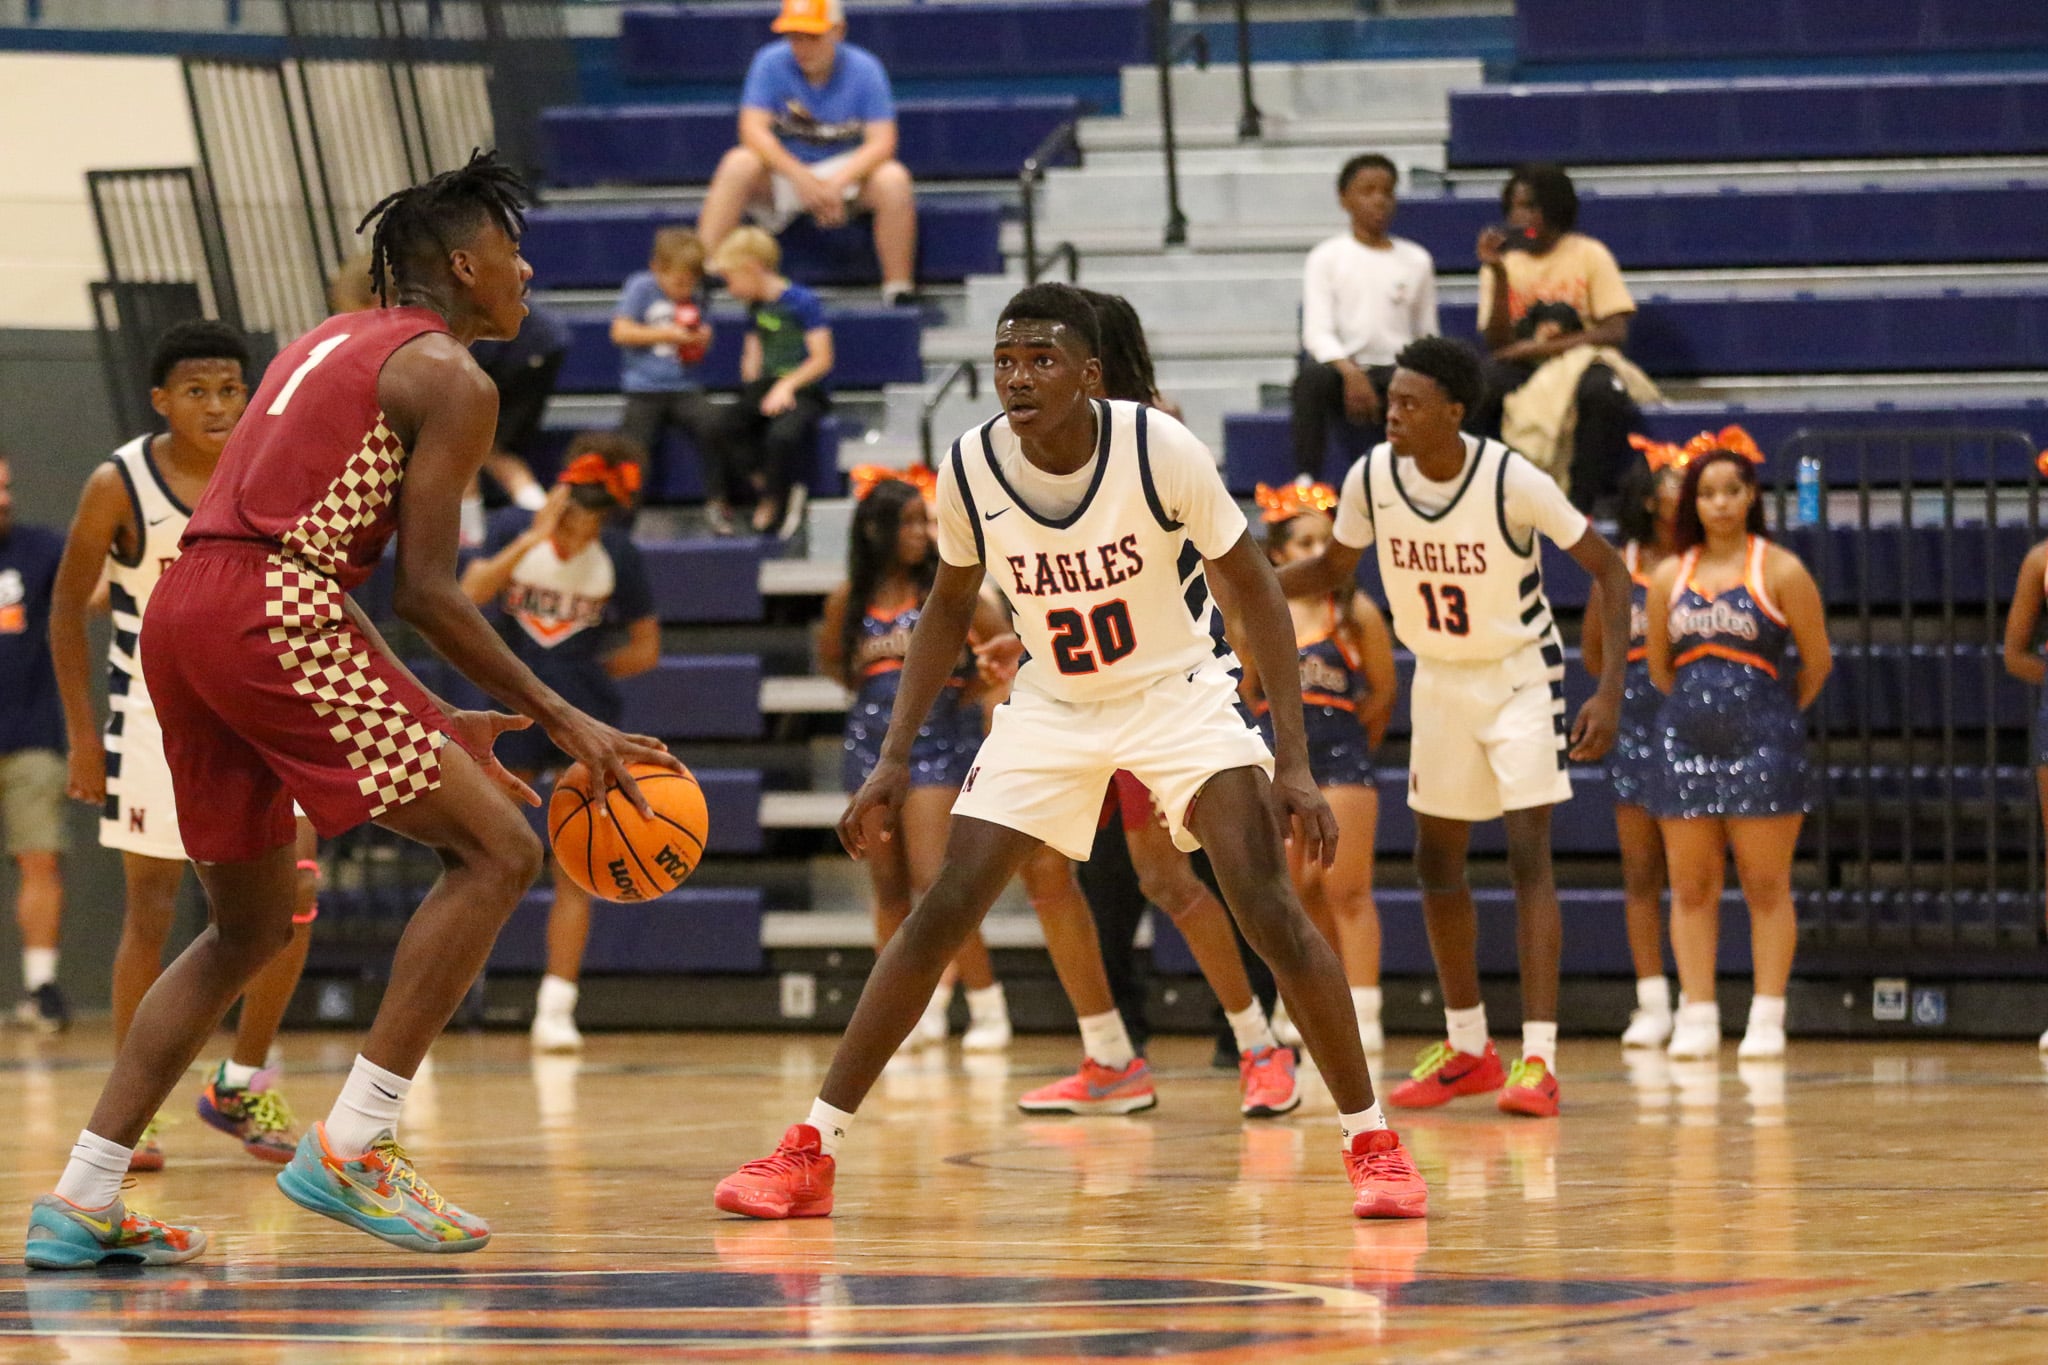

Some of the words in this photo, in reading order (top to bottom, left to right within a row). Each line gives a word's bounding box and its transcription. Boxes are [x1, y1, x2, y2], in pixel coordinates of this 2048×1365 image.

[266, 333, 351, 416] 1
[1006, 533, 1144, 596] EAGLES
[1388, 537, 1488, 575] EAGLES
[1046, 598, 1137, 676] 20
[1418, 581, 1470, 637] 13
[129, 807, 145, 834] N
[654, 844, 692, 883] CAA
